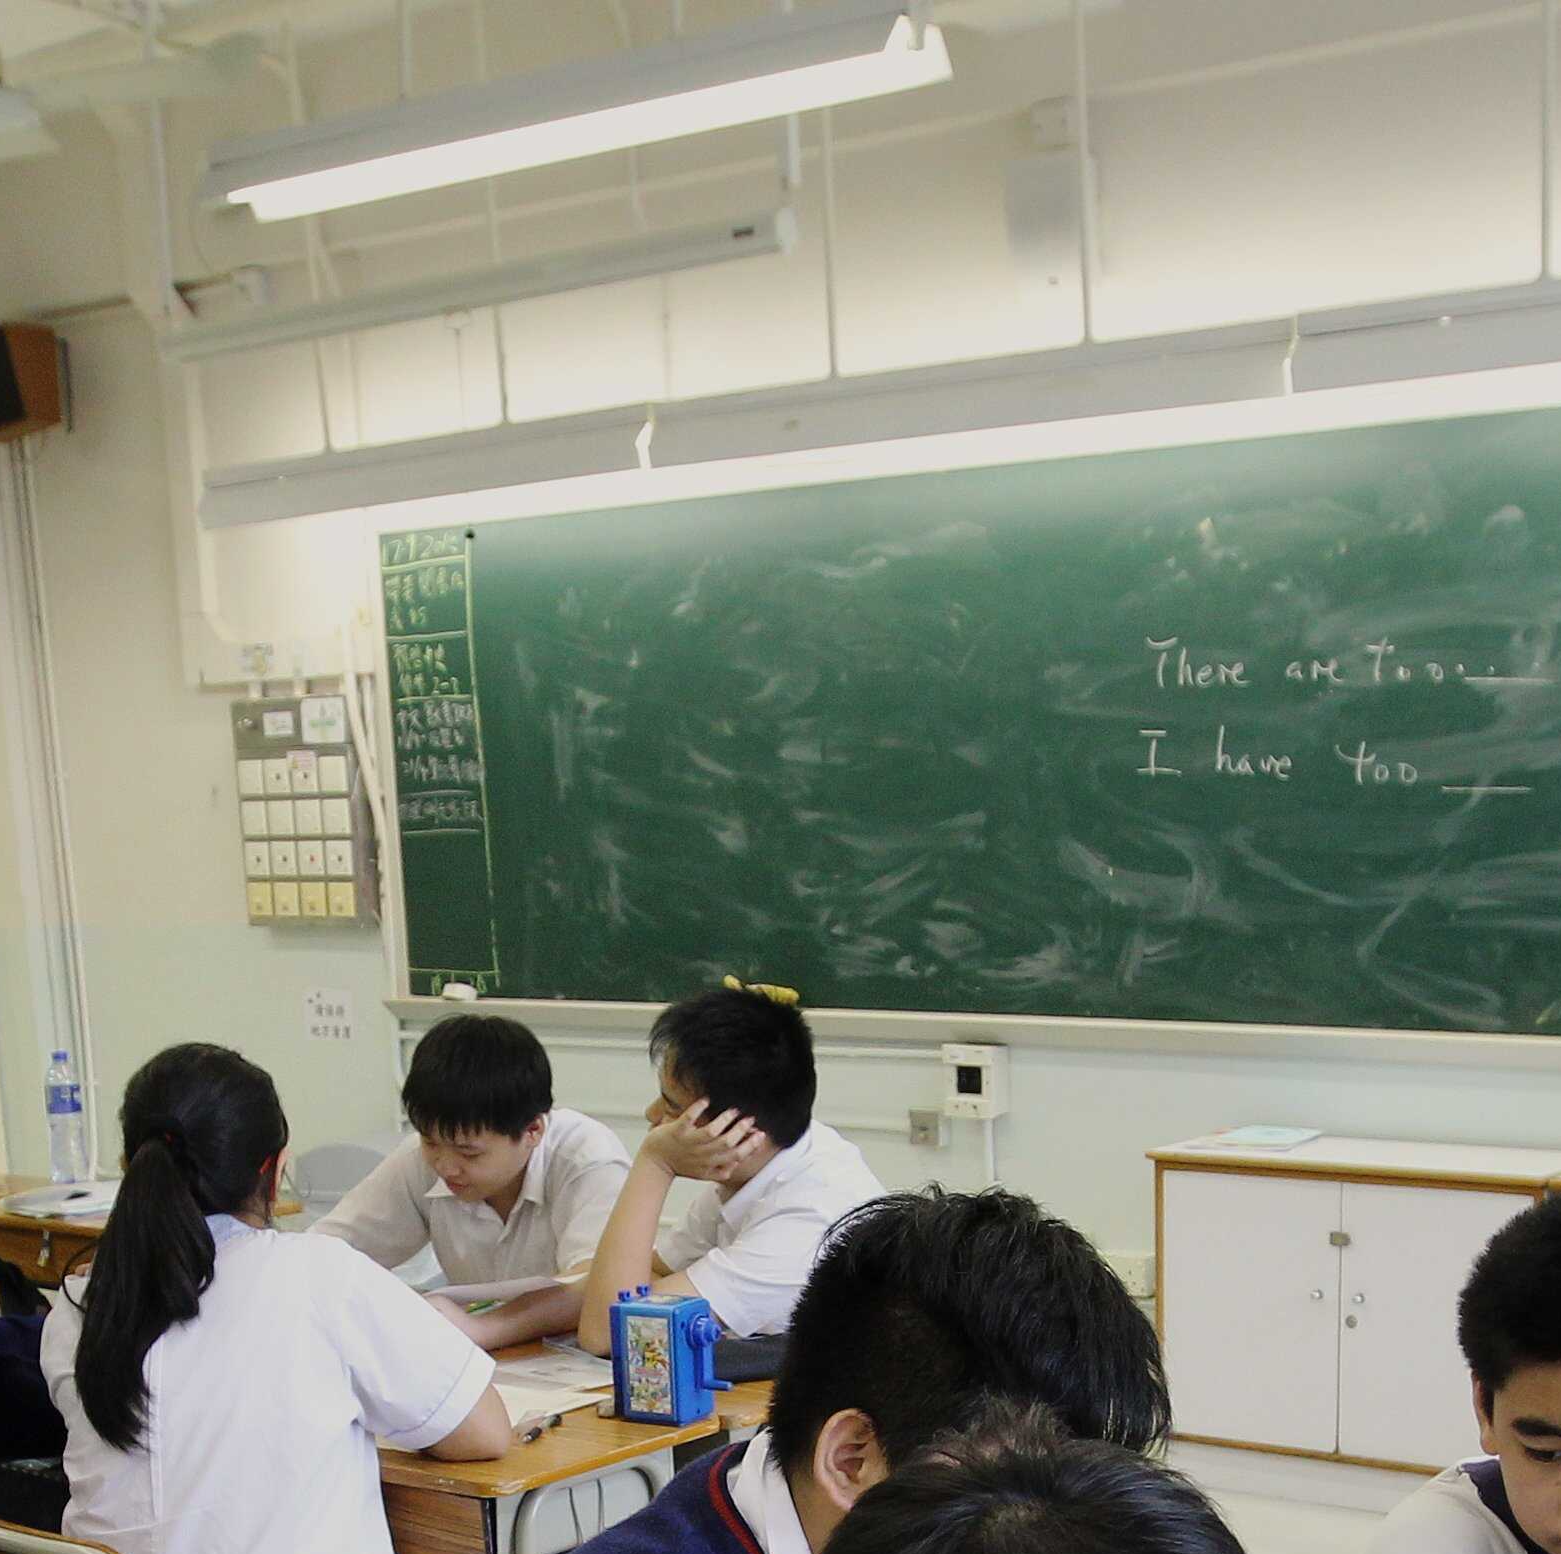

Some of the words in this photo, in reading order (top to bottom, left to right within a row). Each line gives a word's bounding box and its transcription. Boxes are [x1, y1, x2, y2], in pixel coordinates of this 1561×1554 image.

[1144, 634, 1252, 688] There
[1285, 656, 1343, 683] are
[1135, 728, 1182, 778] I
[1216, 724, 1293, 781] have
